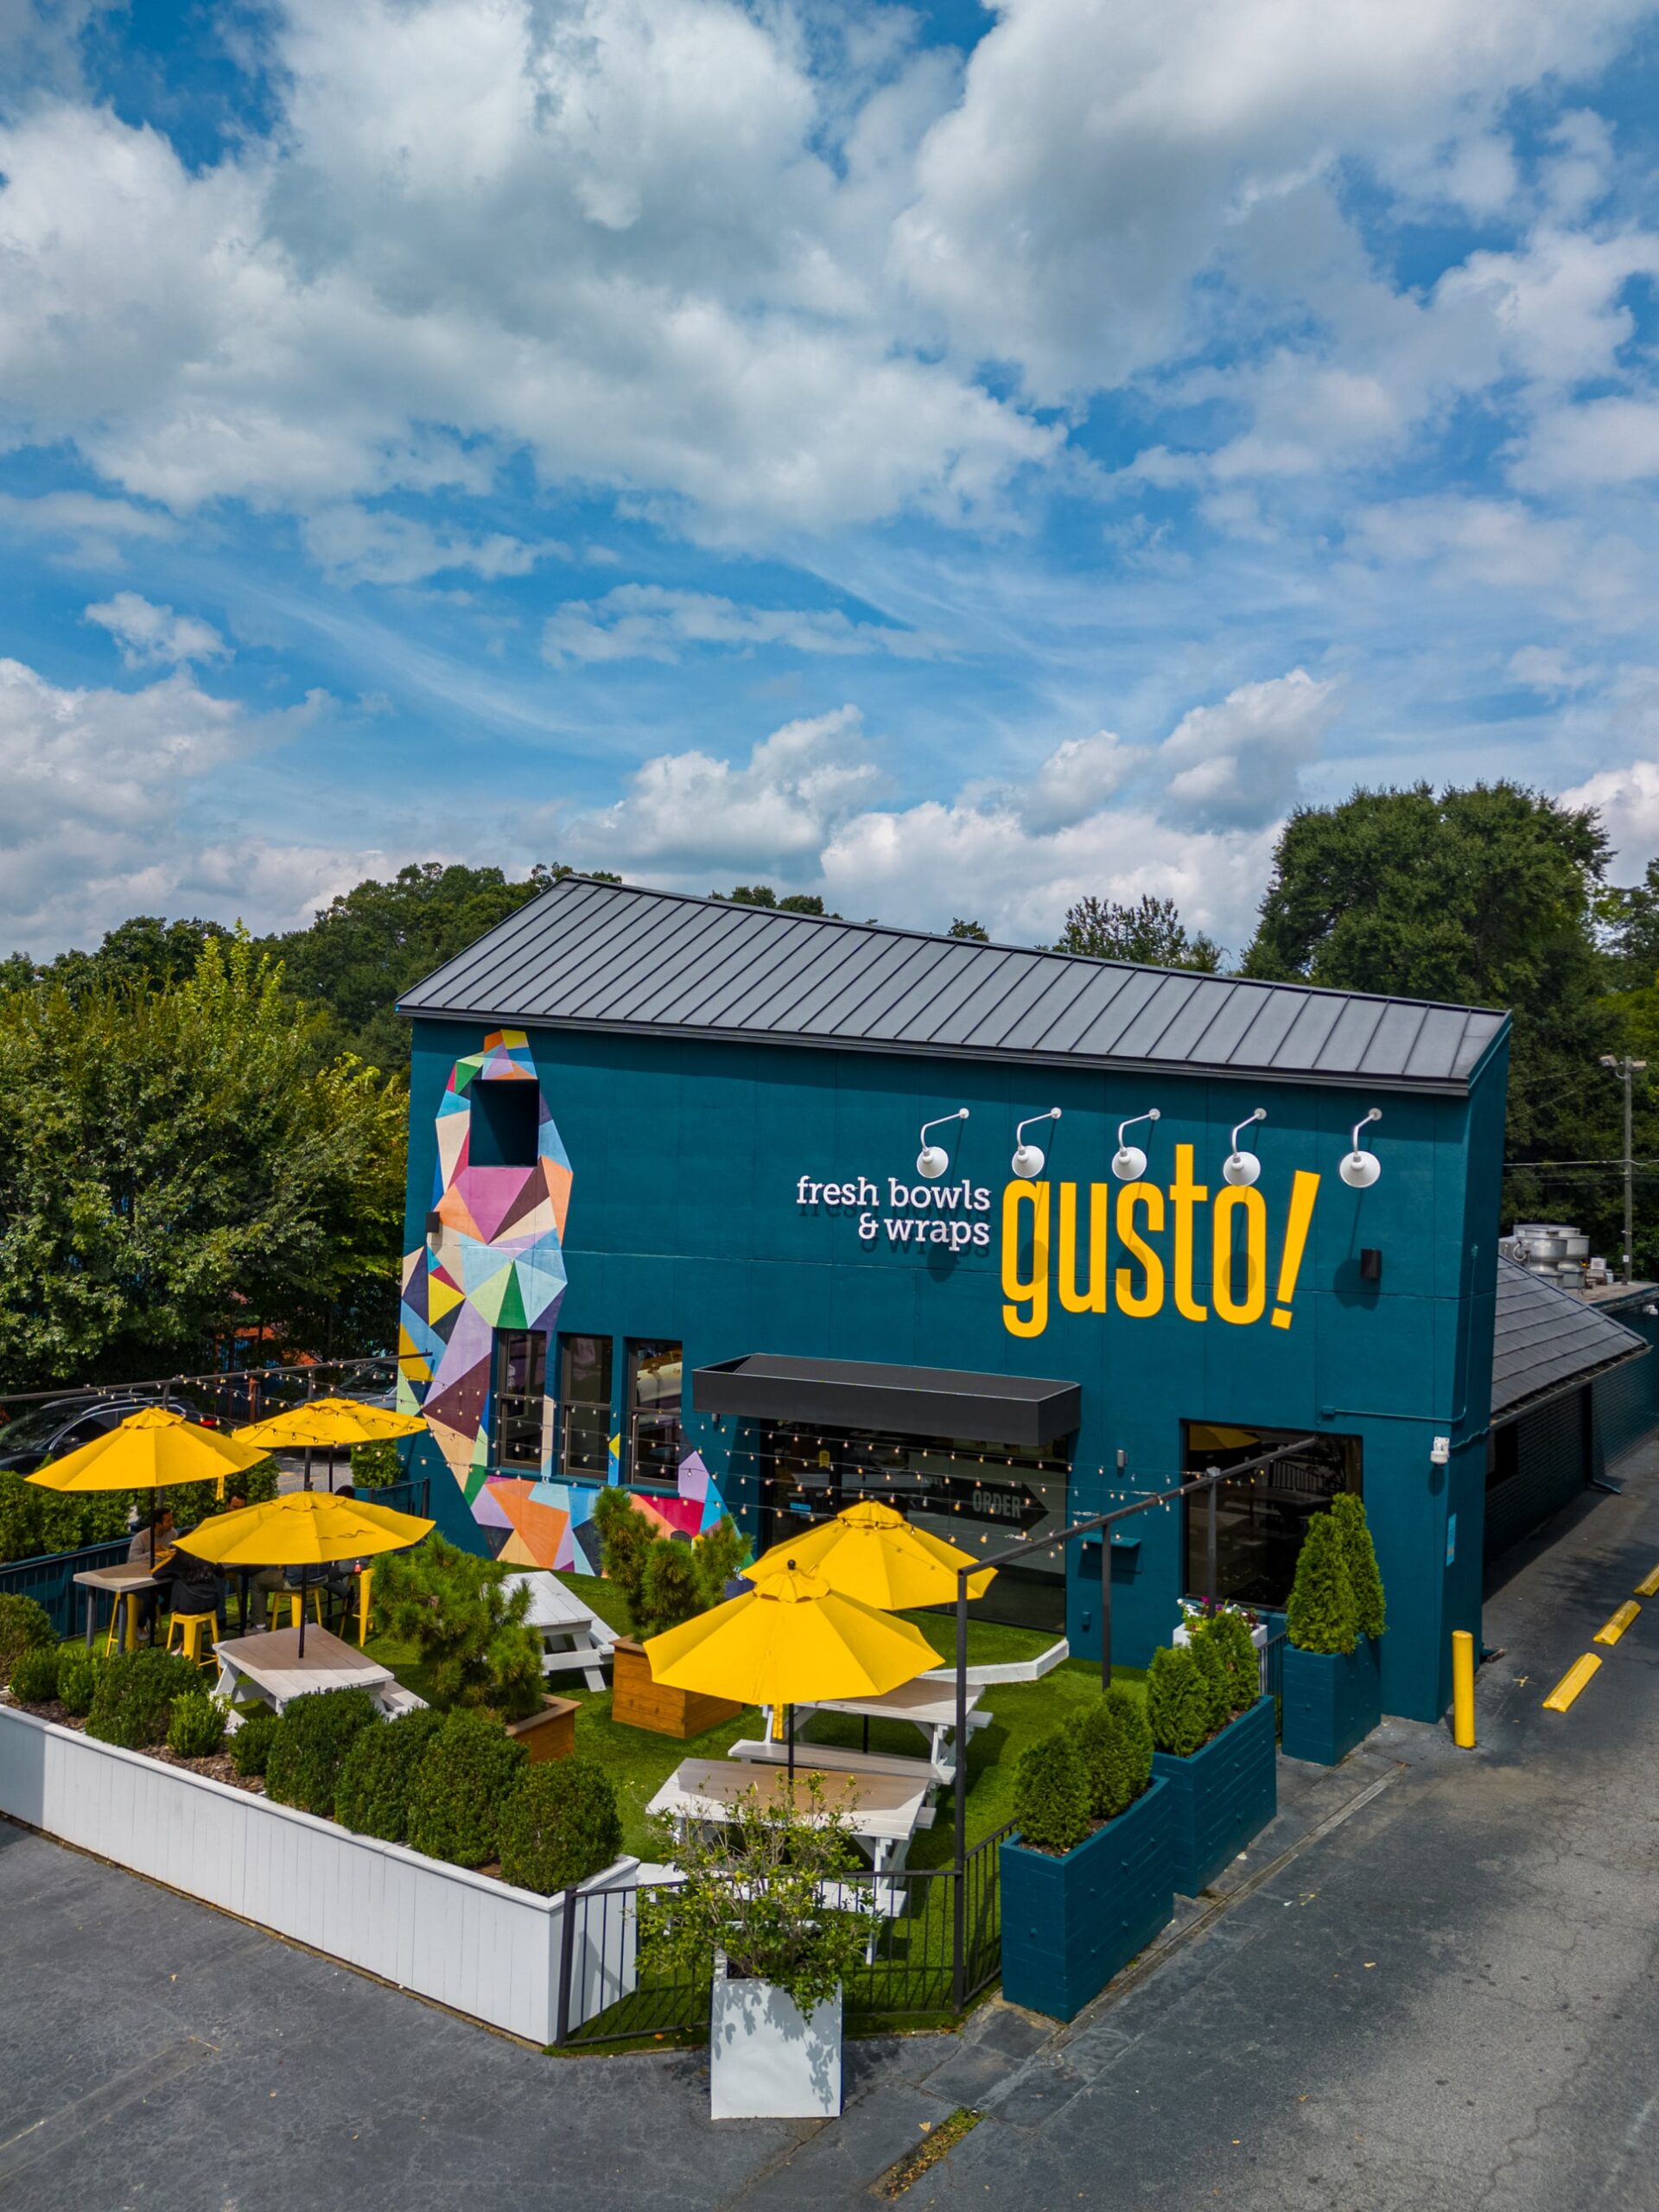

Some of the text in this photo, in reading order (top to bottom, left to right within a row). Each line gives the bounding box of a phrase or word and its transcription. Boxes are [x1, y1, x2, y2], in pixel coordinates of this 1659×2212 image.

[796, 1175, 991, 1211] fresh bowls
[858, 1212, 991, 1251] & wraps
[1001, 1144, 1321, 1338] gusto!
[972, 1490, 1022, 1518] ORDER
